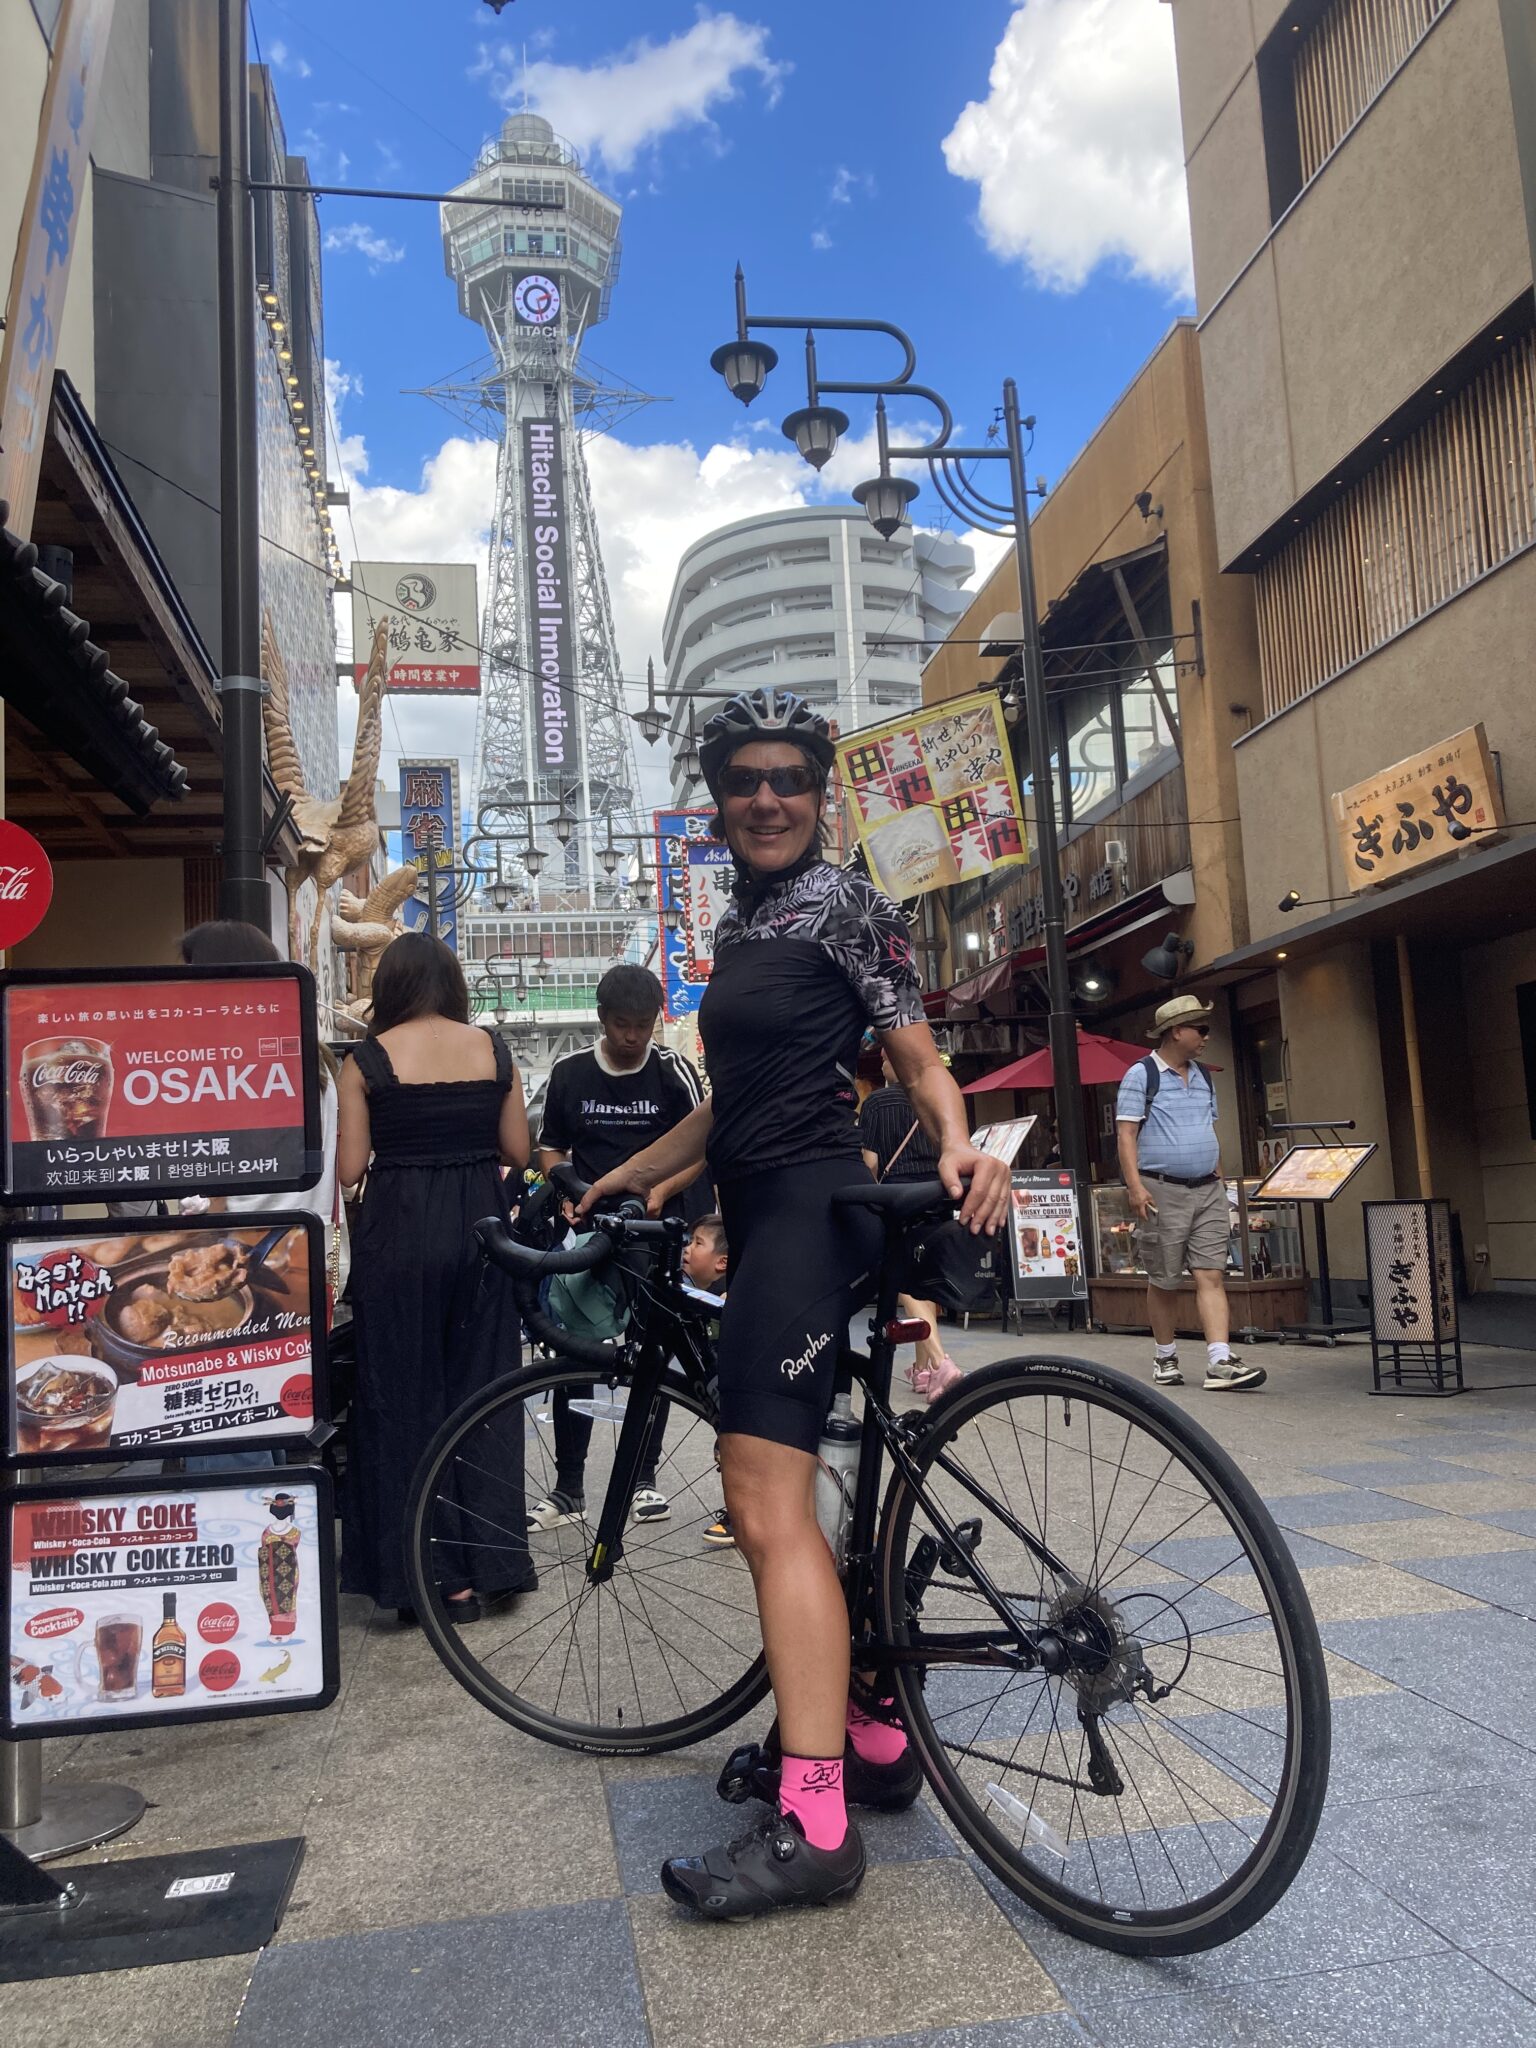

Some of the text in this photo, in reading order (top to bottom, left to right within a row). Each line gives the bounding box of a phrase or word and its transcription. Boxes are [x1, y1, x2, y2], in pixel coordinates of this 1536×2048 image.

[511, 325, 567, 337] HITACHI
[530, 424, 566, 764] Hitachi Social Innovation
[921, 715, 968, 753] 新世界
[936, 733, 982, 773] おやじの
[403, 769, 448, 850] 麻雀
[1352, 775, 1473, 871] ぎふや
[37, 1003, 281, 1025] 楽しい旅の思い出をコカ・コーラとともに
[126, 1048, 216, 1065] WELCOME
[220, 1046, 244, 1060] TO
[32, 1059, 103, 1088] Coca-Cola
[123, 1062, 296, 1106] OSAKA
[580, 1099, 660, 1114] Marseille
[46, 1165, 150, 1187] 欢迎来到大阪
[167, 1157, 279, 1179] 환영합니다 오사카
[1019, 1208, 1040, 1216] WHISKY
[1058, 1207, 1072, 1215] ZERO
[1050, 1194, 1070, 1203] COKE
[17, 1254, 82, 1291] Best
[36, 1268, 114, 1311] Match
[1388, 1258, 1420, 1329] ぎふや
[162, 1319, 270, 1350] Recommended
[142, 1339, 312, 1383] Motsunabe & Wisky Cok
[164, 1378, 203, 1393] ZERO SUGAR
[164, 1379, 254, 1412] 糖類ゼロの
[119, 1405, 279, 1447] コカ・コーラ ゼロ ハイボール
[31, 1503, 197, 1538] WHISKY COKE
[33, 1538, 67, 1549] Whiskey
[119, 1535, 151, 1544] ウィスキー
[159, 1532, 193, 1542] コカ・コーラ
[30, 1543, 235, 1579] WHISKY COKE ZERO
[31, 1581, 65, 1593] Whiskey
[109, 1578, 127, 1587] zero
[133, 1577, 165, 1585] ウィスキー
[173, 1573, 207, 1583] コカ・コーラ
[209, 1572, 222, 1580] ゼロ
[30, 1617, 80, 1637] Cocktails
[200, 1614, 237, 1630] Coca-Cola
